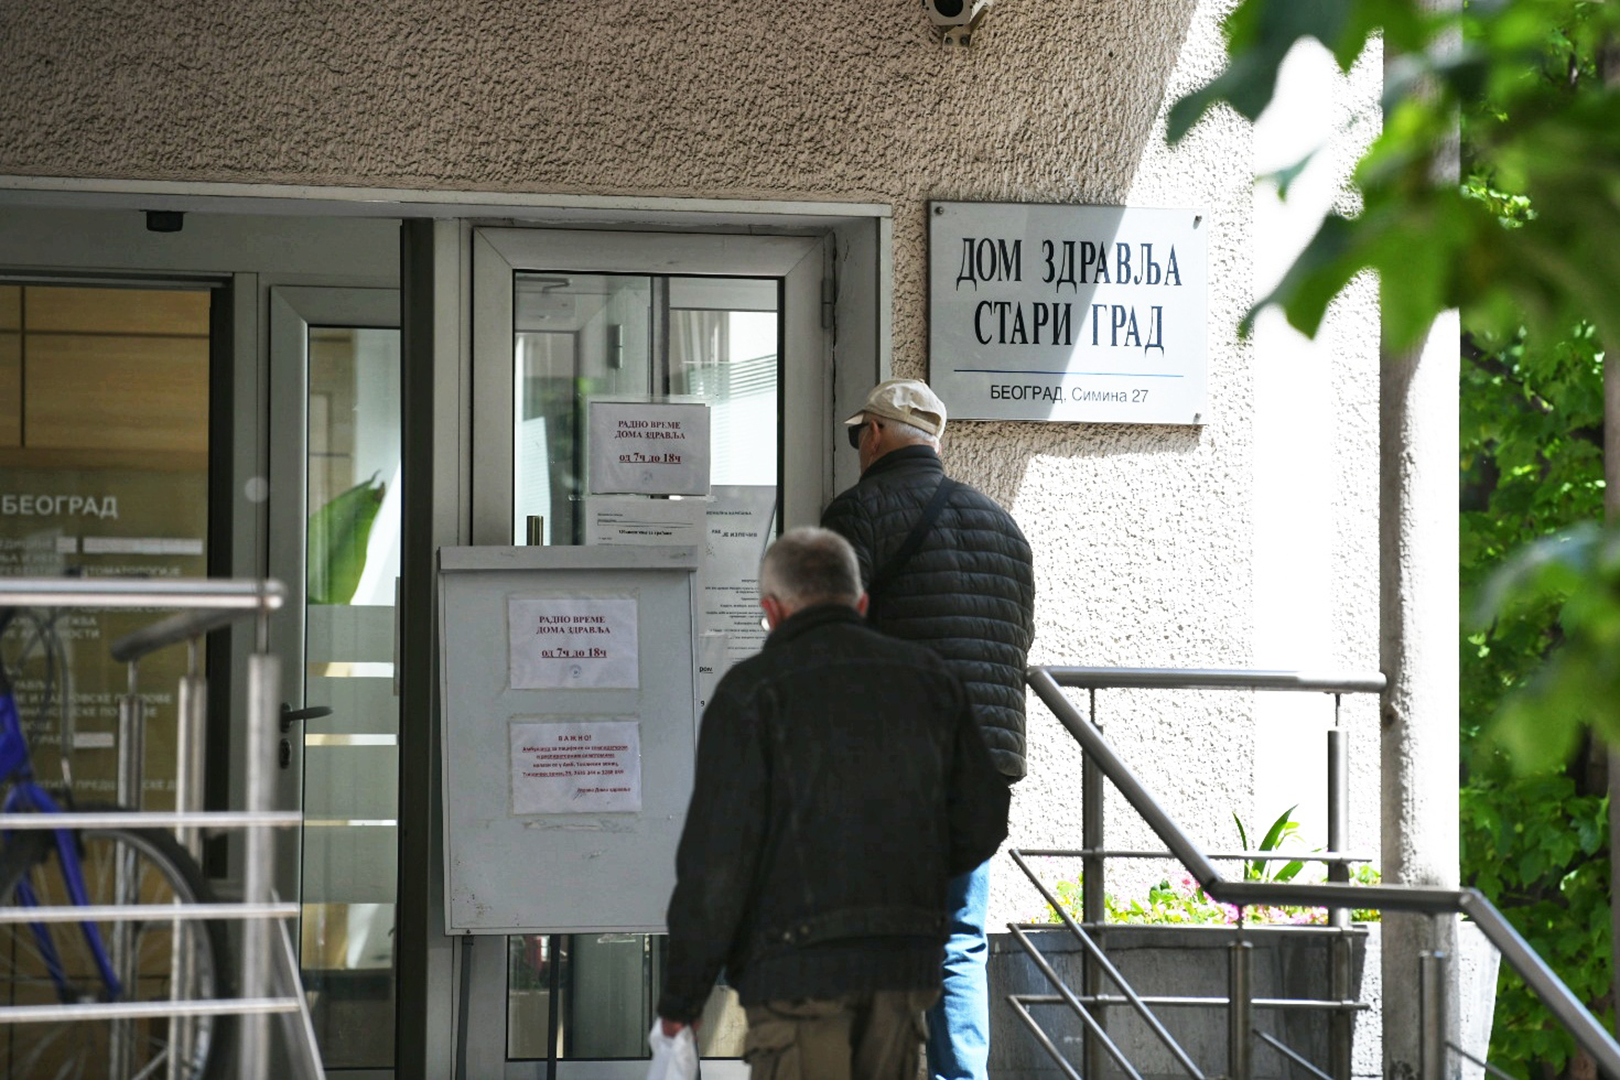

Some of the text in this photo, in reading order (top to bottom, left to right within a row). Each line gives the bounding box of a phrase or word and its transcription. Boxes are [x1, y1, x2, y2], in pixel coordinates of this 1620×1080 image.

[956, 237, 1183, 294] ДОМ ЗДРАВЉА
[974, 300, 1165, 358] СТАРИ ГРАД
[990, 384, 1150, 404] БЕОГРАД, Симина 27
[618, 420, 681, 430] РАДНО ВРЕМЕ
[615, 430, 686, 440] ДОМА ЗДРАВЉА
[619, 452, 682, 464] од 7ч до 18ч
[1, 494, 119, 519] БЕОГРАД
[539, 615, 606, 624] РАДНО ВРЕМЕ
[536, 626, 611, 635] ДОМА ЗДРАВЉА
[541, 647, 608, 659] од 7ч до 18ч
